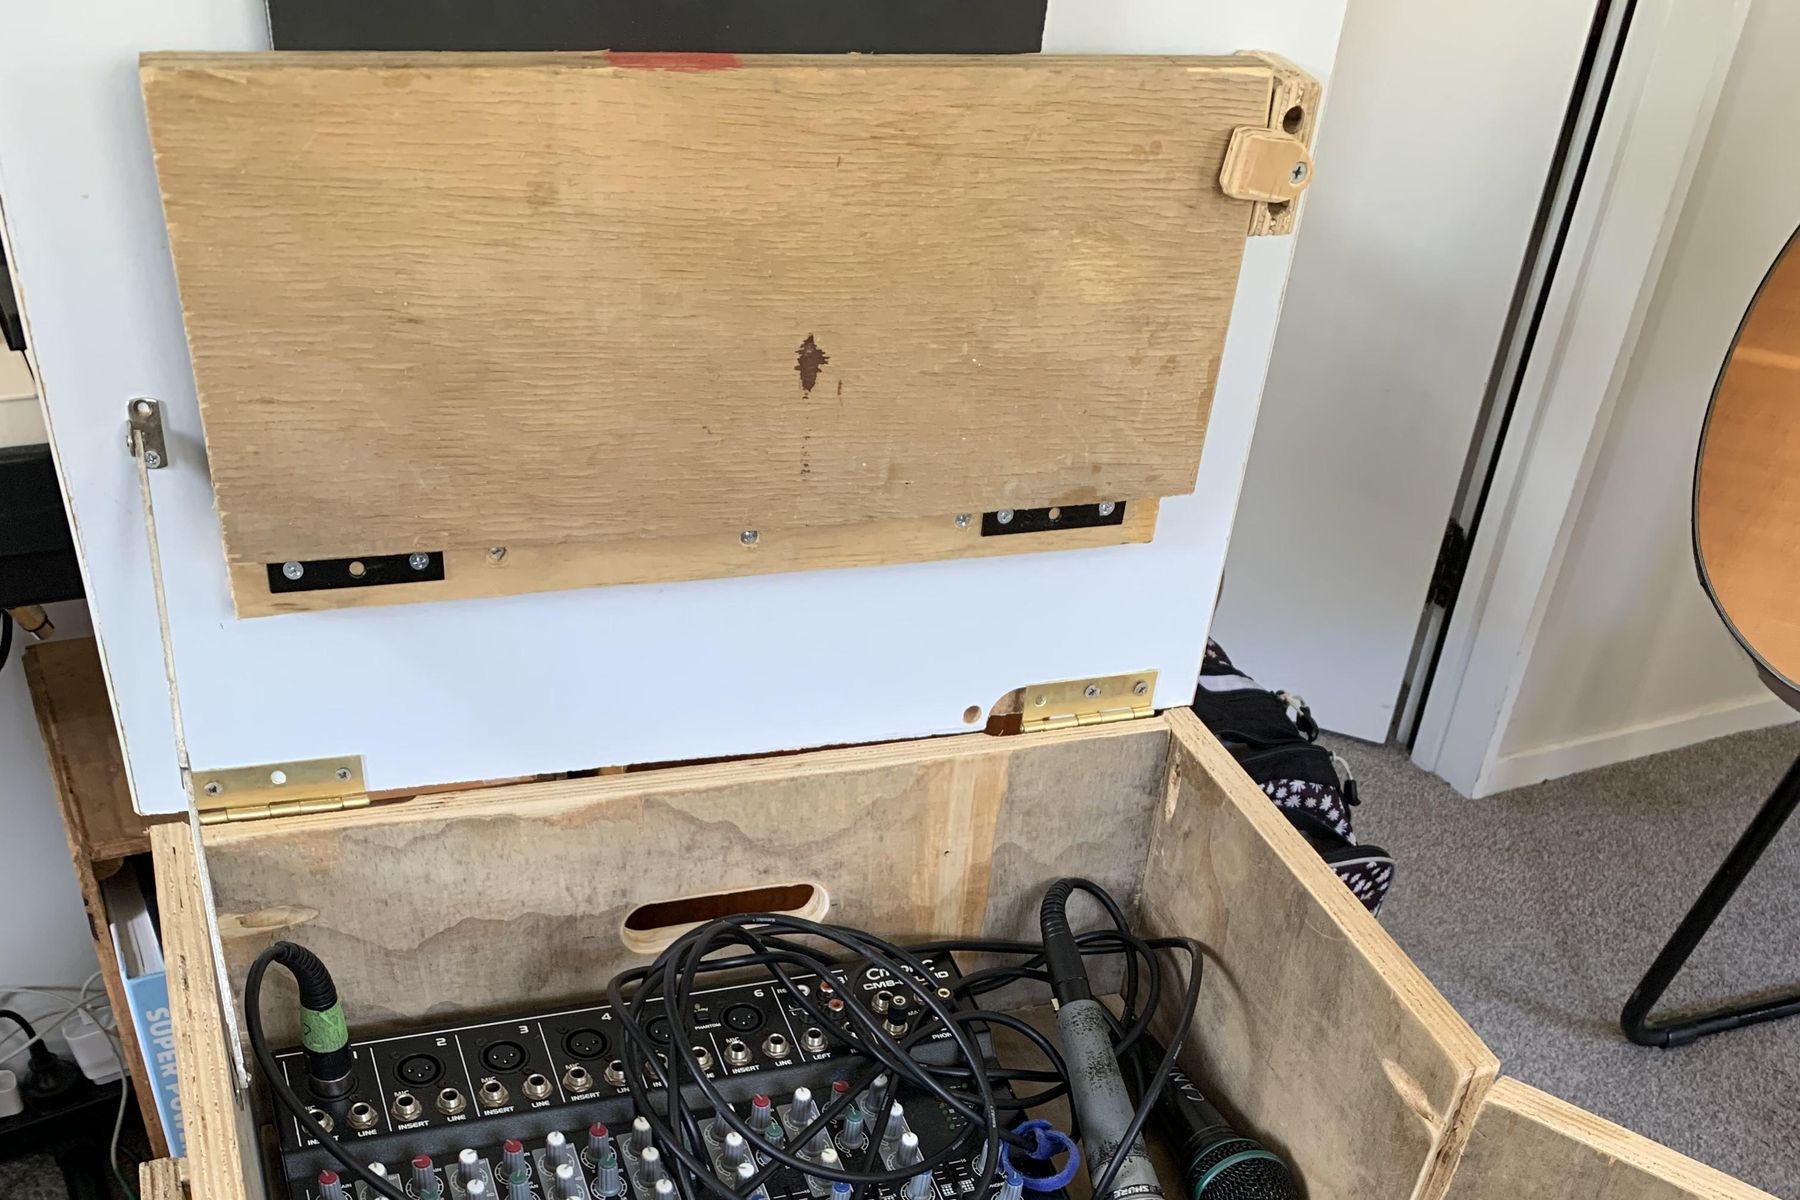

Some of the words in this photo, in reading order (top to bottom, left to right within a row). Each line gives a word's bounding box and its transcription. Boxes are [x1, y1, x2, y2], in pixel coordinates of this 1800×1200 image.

[753, 988, 765, 998] 6
[601, 1012, 612, 1021] 4
[518, 1025, 529, 1034] 3
[694, 1022, 722, 1031] PHANTOM
[435, 1037, 447, 1047] 2
[352, 1050, 358, 1060] 1
[812, 1052, 832, 1061] LEFT
[774, 1059, 793, 1067] LINE
[731, 1064, 760, 1075] INSERT
[570, 1091, 601, 1102] INSERT
[531, 1100, 551, 1108] LINE
[483, 1105, 515, 1116] INSERT
[446, 1114, 467, 1122] LINE
[398, 1120, 430, 1131] INSERT
[357, 1129, 378, 1137] LINE
[1113, 1185, 1150, 1199] SHURE
